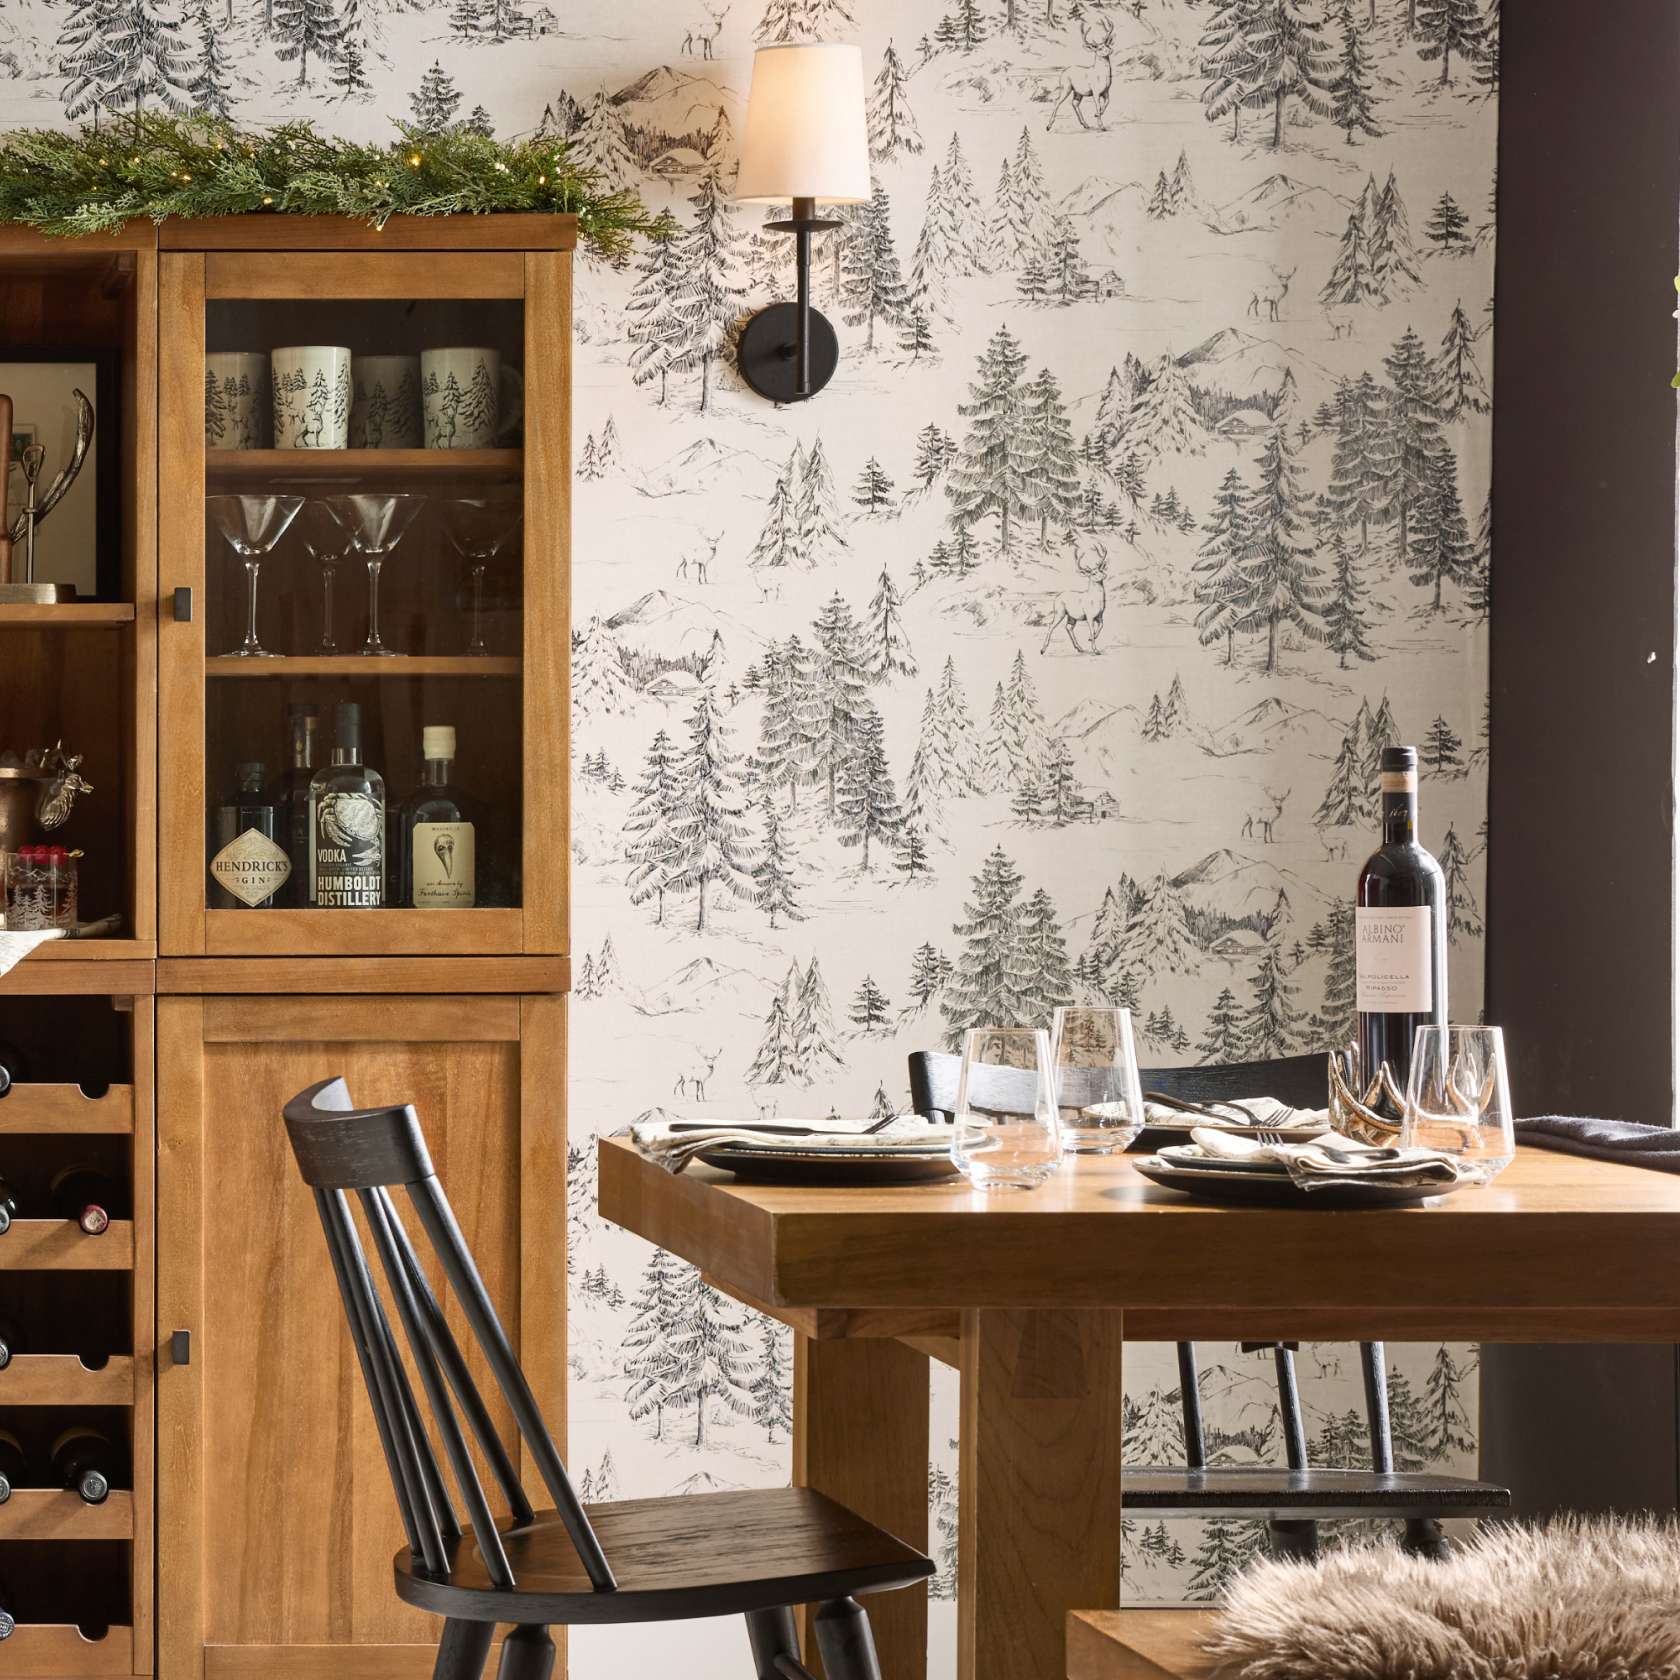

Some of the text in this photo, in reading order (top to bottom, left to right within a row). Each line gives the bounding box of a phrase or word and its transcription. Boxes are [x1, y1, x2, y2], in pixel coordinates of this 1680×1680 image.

[318, 849, 346, 862] VODKA
[216, 861, 288, 872] HENDRICK'S
[242, 876, 265, 884] GIN
[318, 876, 381, 890] HUMBOLDT
[318, 892, 381, 905] DISTILLERY
[1362, 934, 1403, 944] ARMANI
